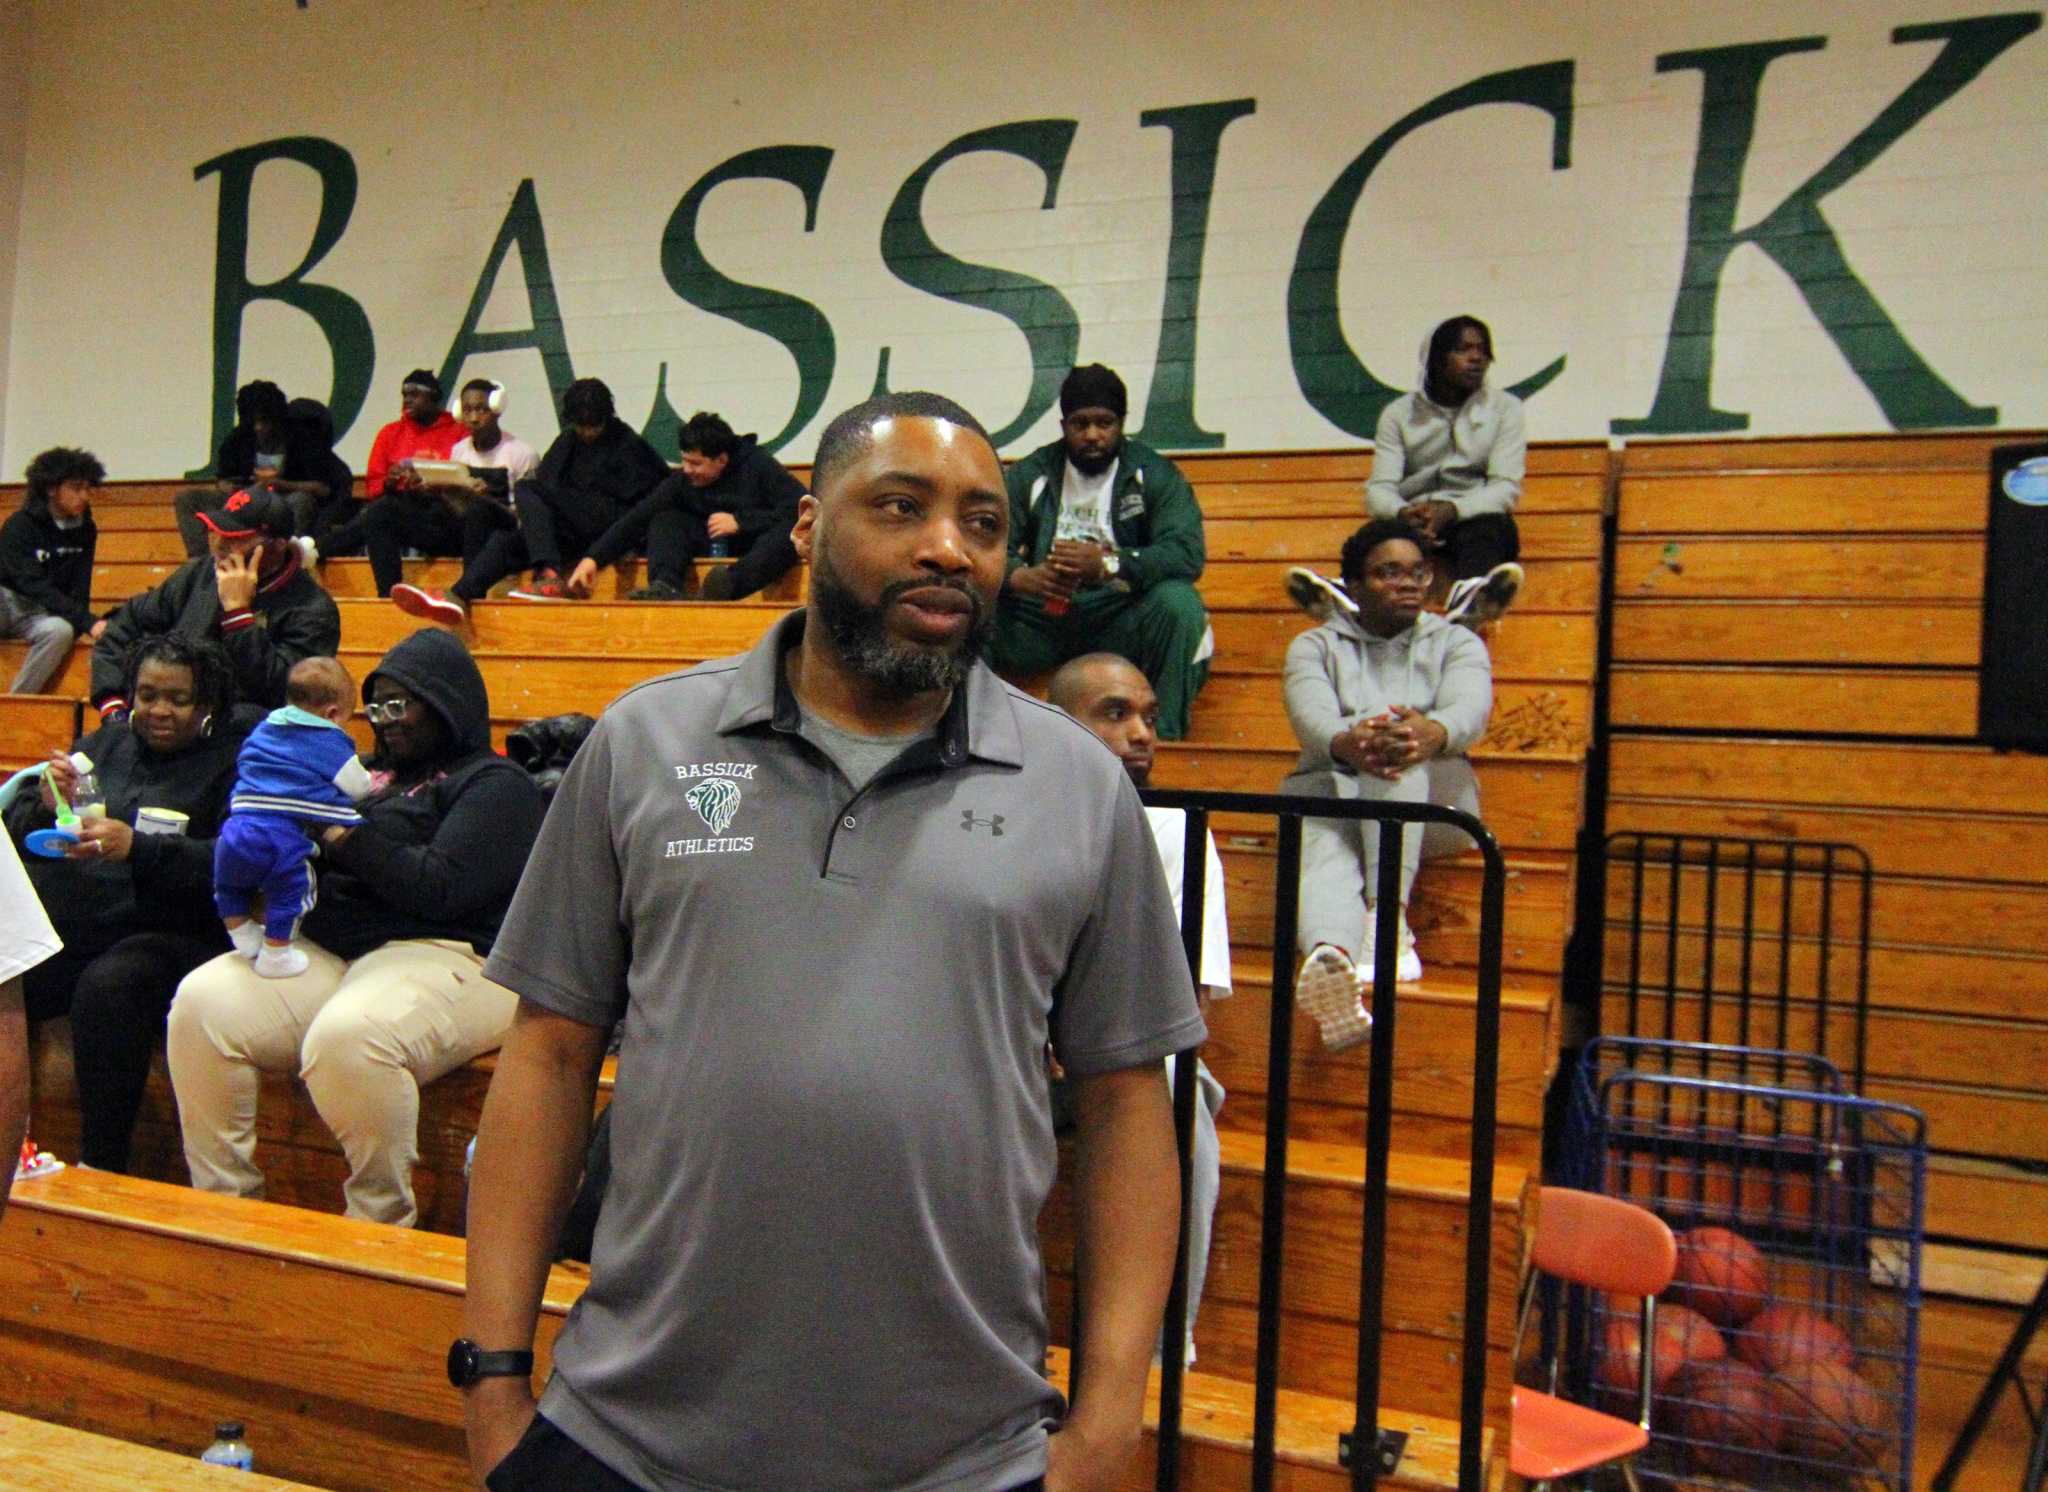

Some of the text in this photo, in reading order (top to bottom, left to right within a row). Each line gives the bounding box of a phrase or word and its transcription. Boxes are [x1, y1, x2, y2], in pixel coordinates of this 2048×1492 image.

[184, 12, 2043, 477] BASSICK
[674, 762, 758, 779] BASSICK
[665, 836, 755, 857] ATHLETICS
